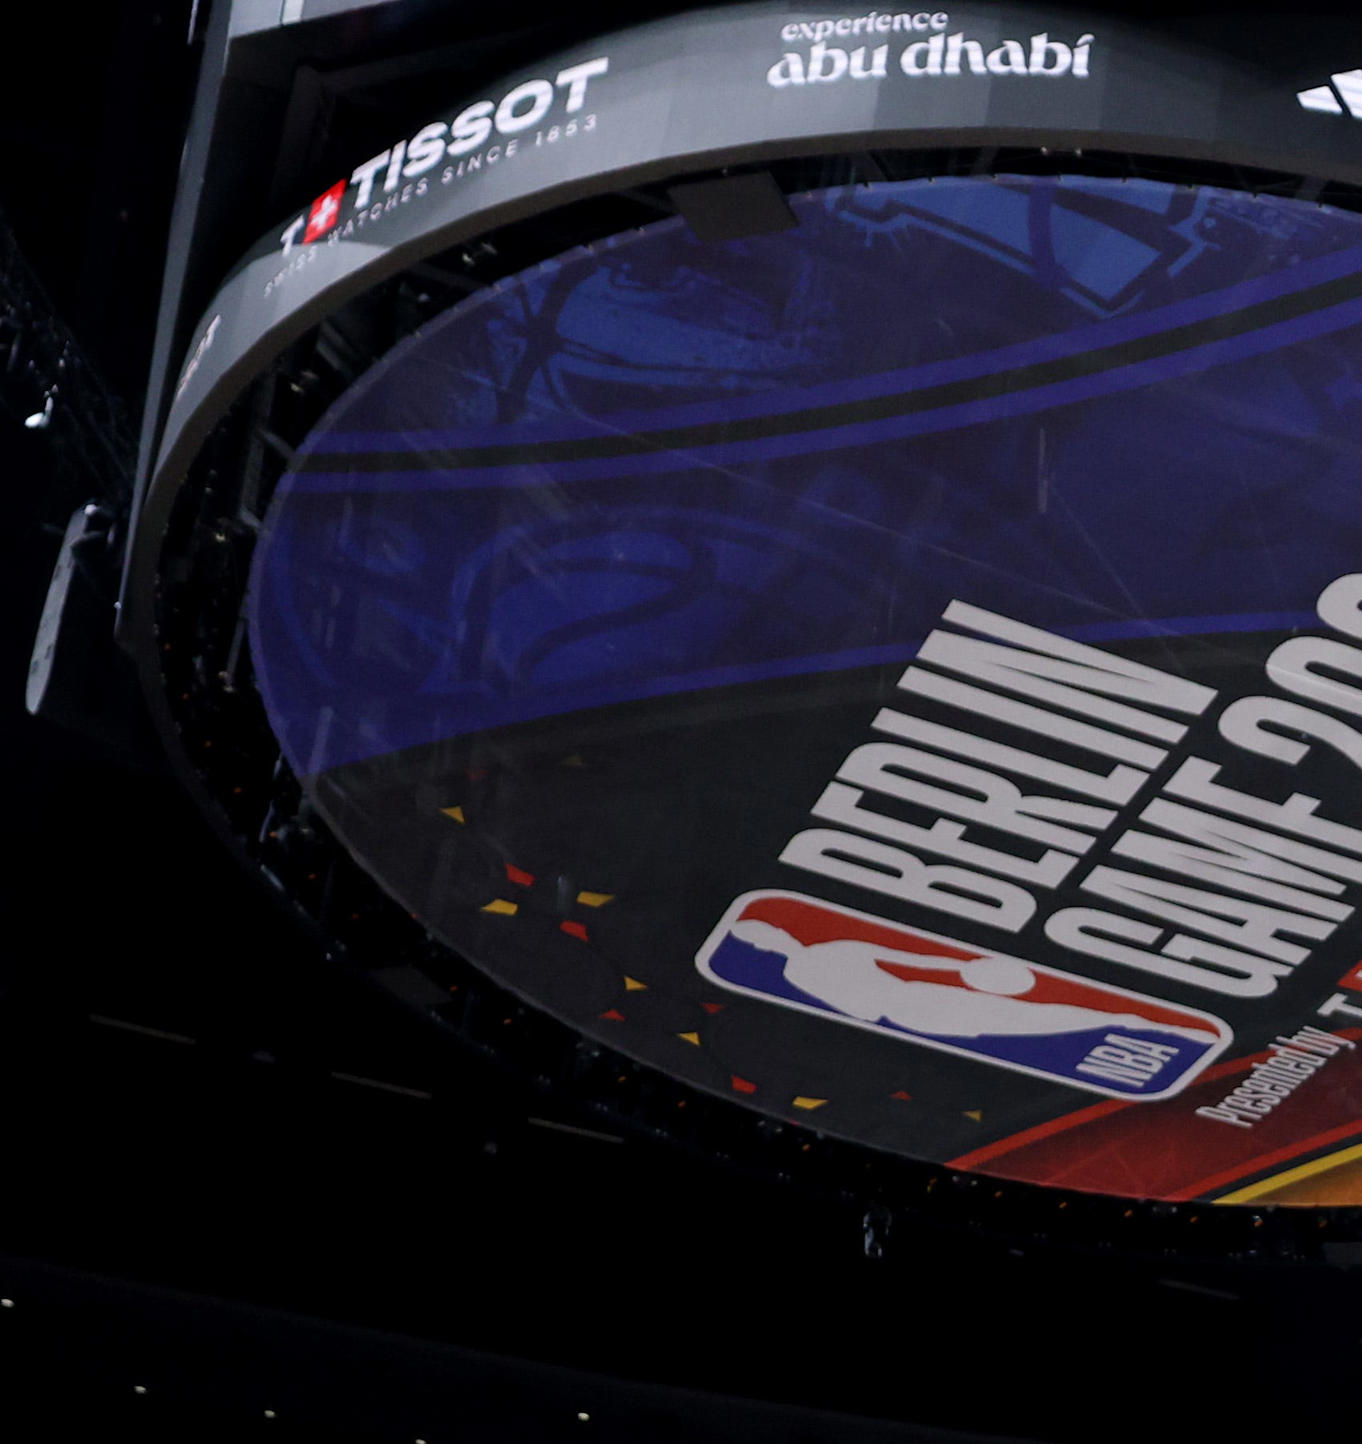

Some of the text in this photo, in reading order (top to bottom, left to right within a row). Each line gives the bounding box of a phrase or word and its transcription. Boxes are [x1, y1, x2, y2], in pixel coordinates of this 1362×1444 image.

[767, 32, 1095, 89] abu dhabi
[781, 10, 948, 43] experience
[328, 178, 428, 247] WATCHES
[442, 142, 518, 183] SINCE
[535, 114, 597, 147] 1853
[350, 57, 609, 209] TISSOT
[779, 600, 1218, 932] BERLIN
[1077, 1033, 1180, 1088] NBA
[1195, 1025, 1356, 1128] Presented by
